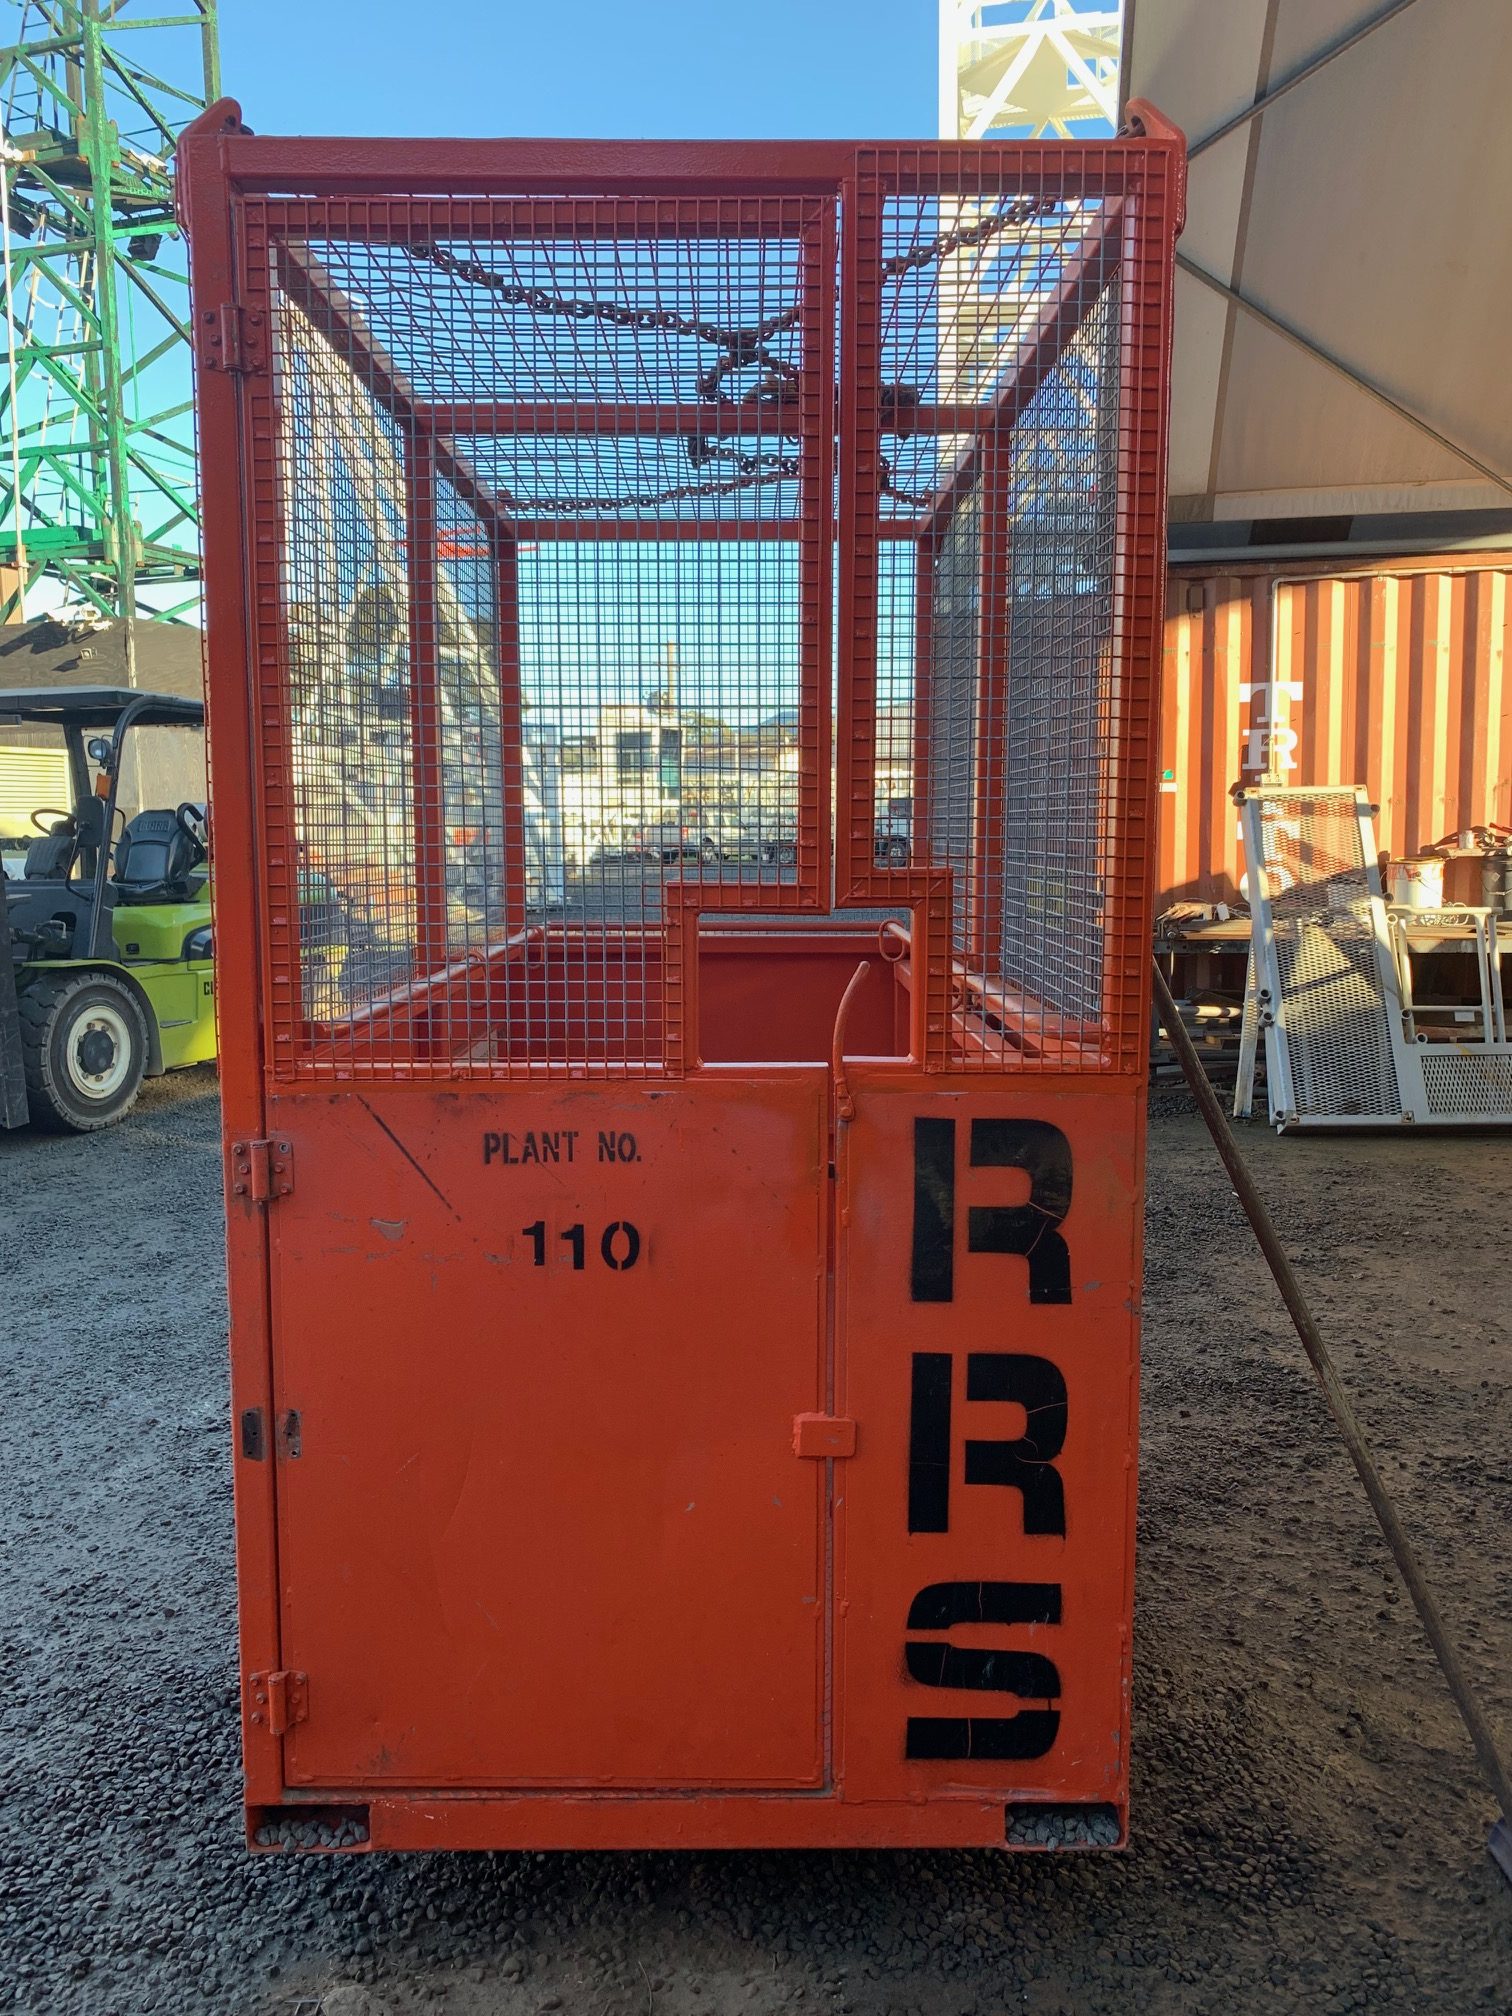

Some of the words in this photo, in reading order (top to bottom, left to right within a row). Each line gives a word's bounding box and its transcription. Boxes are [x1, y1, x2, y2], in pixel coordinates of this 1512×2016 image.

[483, 1131, 579, 1165] PLANT
[597, 1130, 642, 1163] NO.
[522, 1220, 641, 1271] 110
